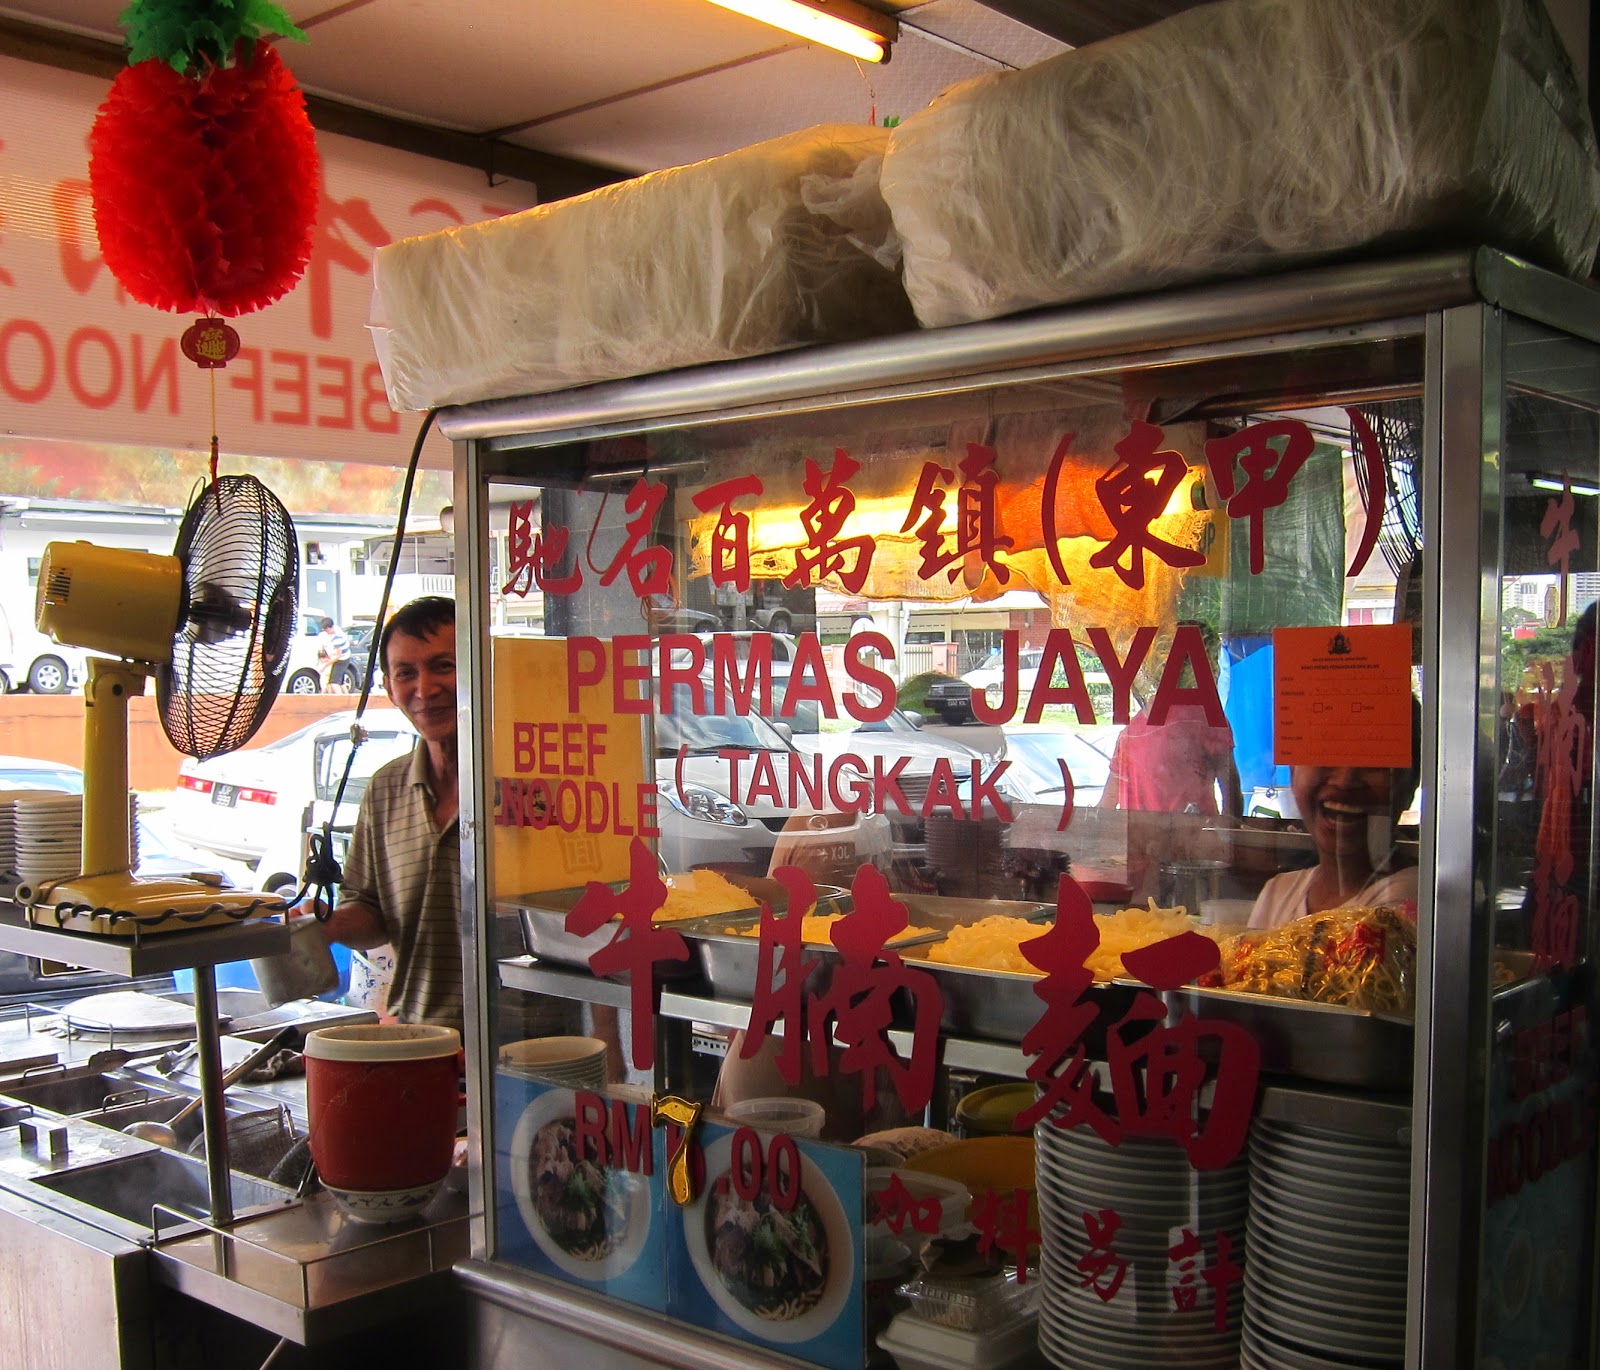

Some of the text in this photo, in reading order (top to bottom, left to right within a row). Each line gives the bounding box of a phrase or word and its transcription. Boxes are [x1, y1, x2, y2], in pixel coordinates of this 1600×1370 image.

[567, 626, 1230, 729] PERMAS JAYA
[513, 722, 607, 776] BEEF
[502, 777, 663, 838] NOODLE
